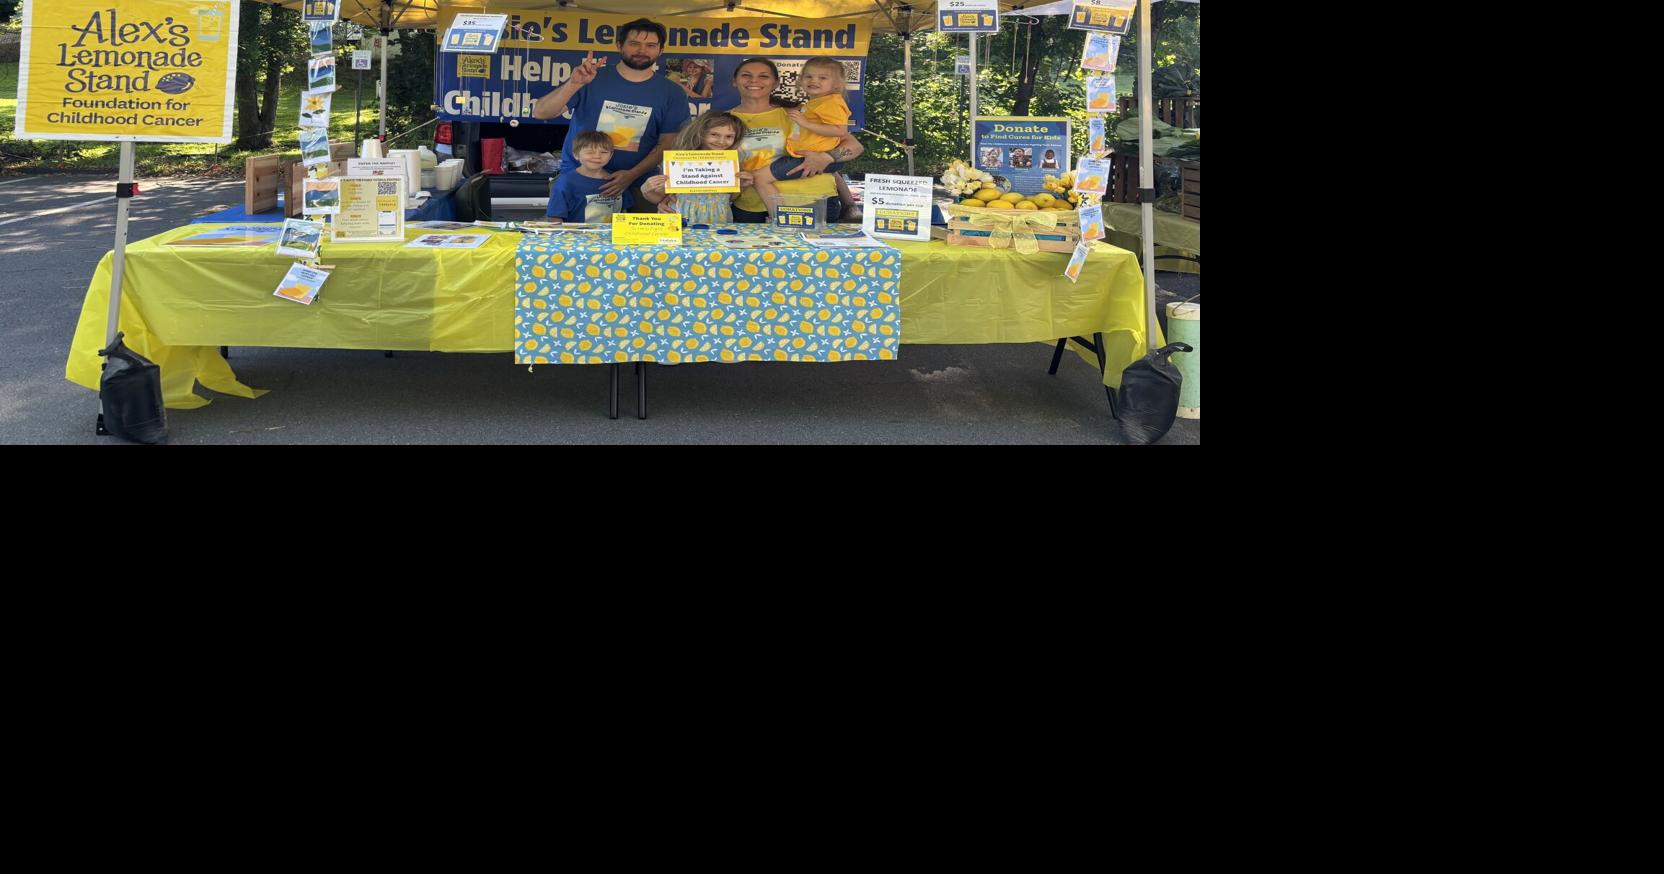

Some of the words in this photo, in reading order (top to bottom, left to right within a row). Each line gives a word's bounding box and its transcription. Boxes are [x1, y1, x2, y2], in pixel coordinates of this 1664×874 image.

[71, 8, 190, 47] Alex's
[579, 18, 749, 47] Lenade
[759, 23, 856, 49] Stand
[56, 43, 203, 71] Lemonade
[501, 55, 572, 86] Help
[65, 68, 151, 94] Stand
[63, 97, 161, 110] Foundation
[165, 98, 191, 111] for
[47, 112, 137, 126] Childhood
[142, 114, 204, 127] Cancer
[994, 124, 1049, 133] Donate
